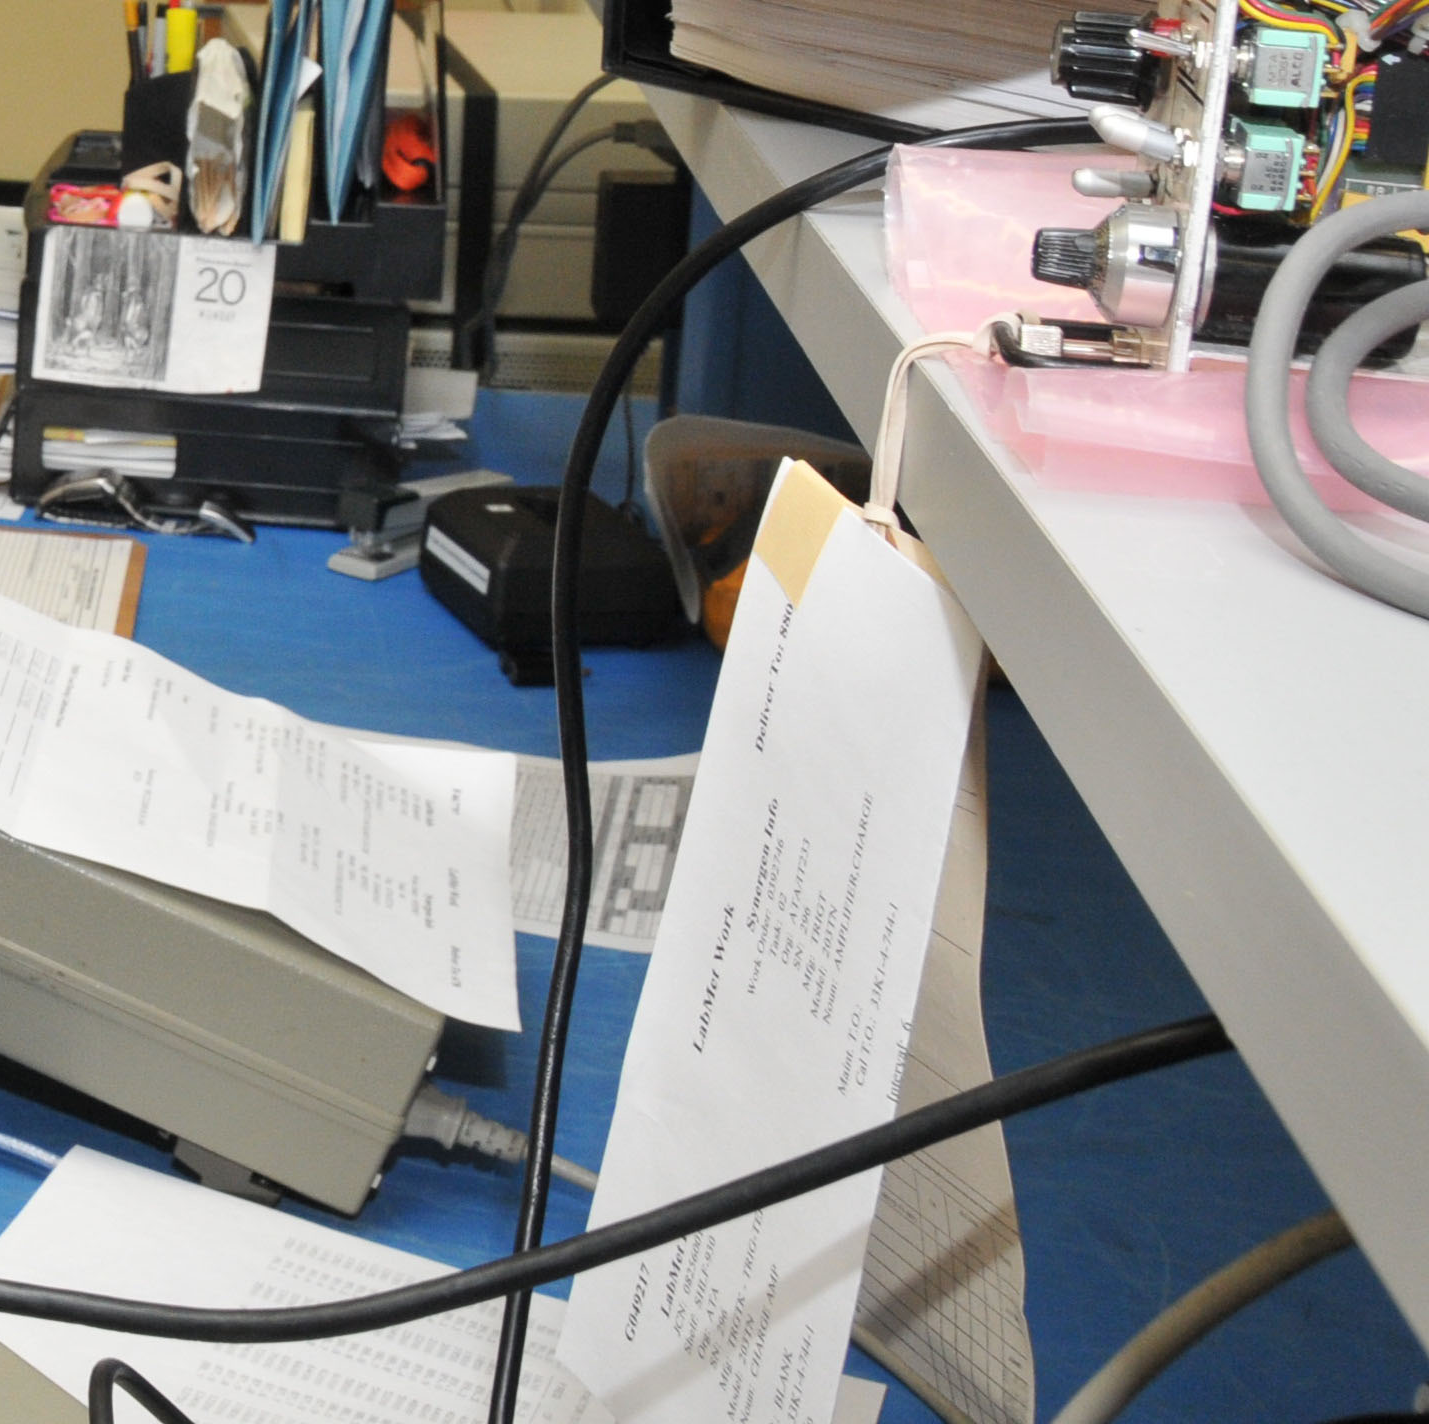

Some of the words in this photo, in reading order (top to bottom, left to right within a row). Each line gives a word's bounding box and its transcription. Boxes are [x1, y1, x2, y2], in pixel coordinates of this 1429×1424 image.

[1290, 52, 1305, 88] ALCO
[194, 266, 247, 307] 20
[755, 682, 774, 753] Deliver
[769, 644, 784, 675] To:
[746, 843, 770, 933] Synergen
[764, 798, 778, 838] Info
[692, 968, 720, 1054] LabMet
[713, 906, 735, 961] Work
[746, 959, 762, 995] Work
[855, 1057, 868, 1087] Cal
[624, 1262, 650, 1342] G049217
[660, 1244, 685, 1318] LabMet
[765, 1264, 779, 1306] AMP
